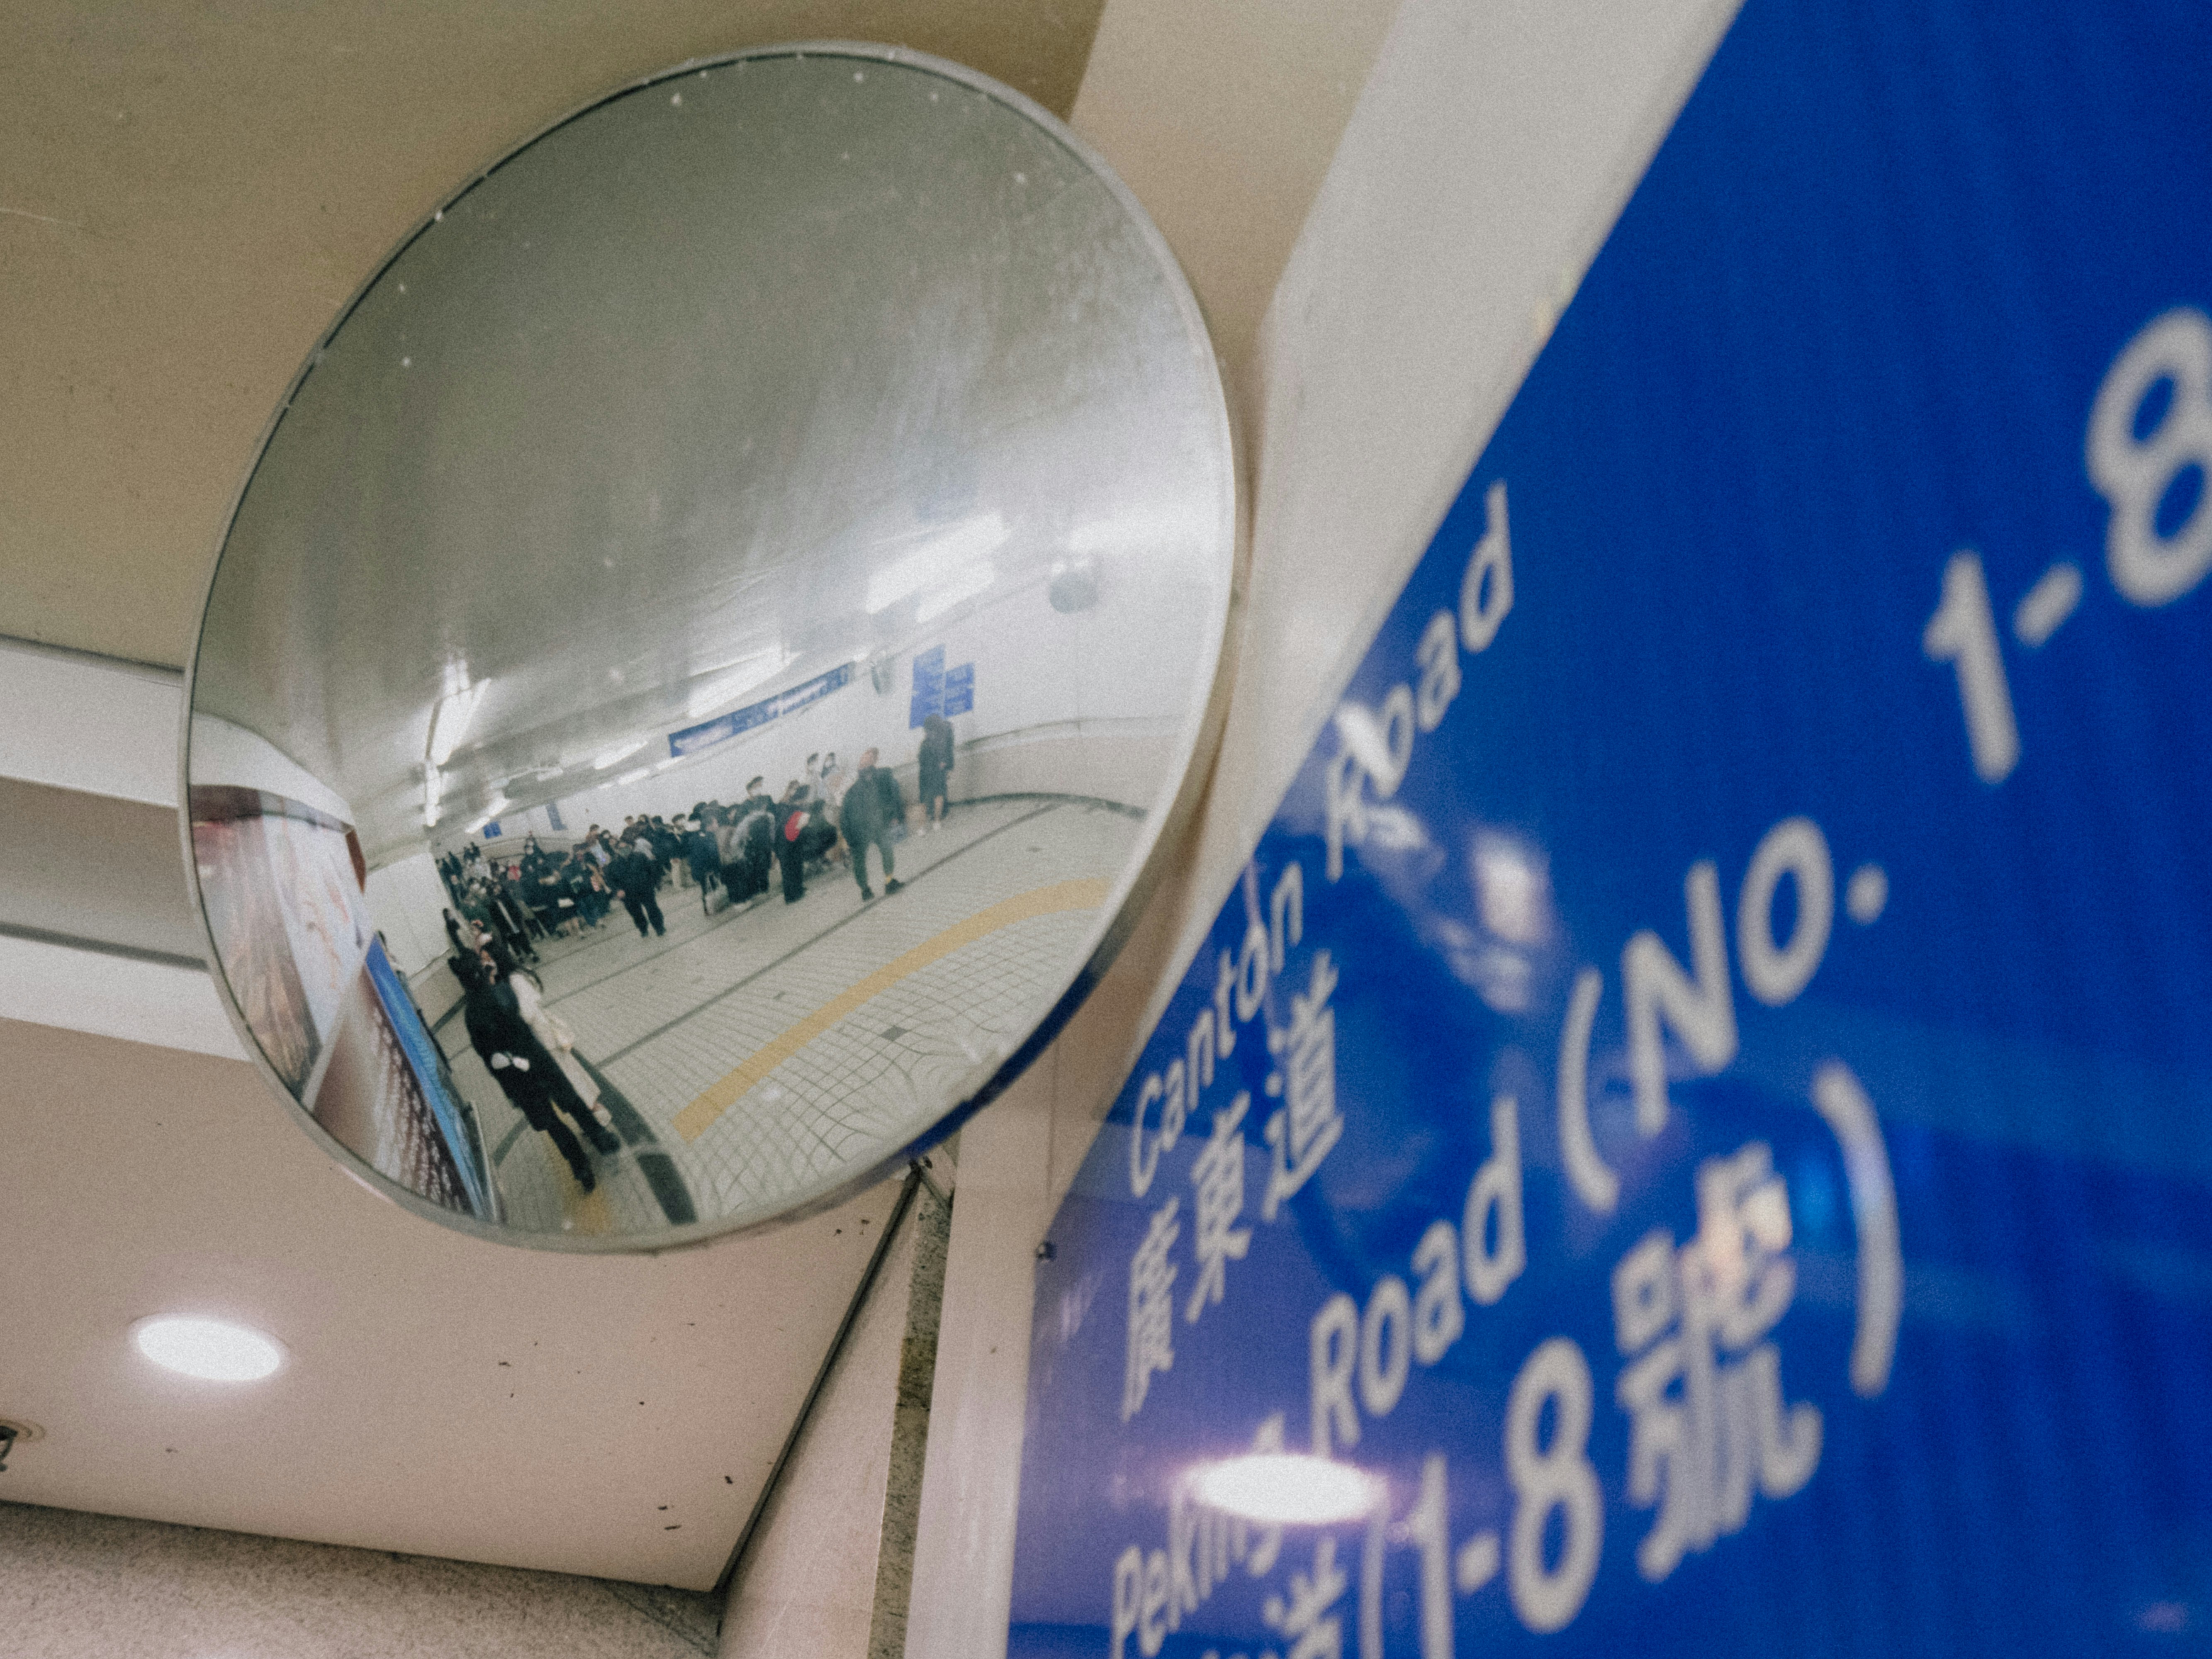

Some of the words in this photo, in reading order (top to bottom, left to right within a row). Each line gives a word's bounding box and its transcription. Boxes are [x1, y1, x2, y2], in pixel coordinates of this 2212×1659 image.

[1127, 859, 1303, 1199] Canton
[1326, 478, 1516, 883] Road
[1309, 1095, 1526, 1470] Road
